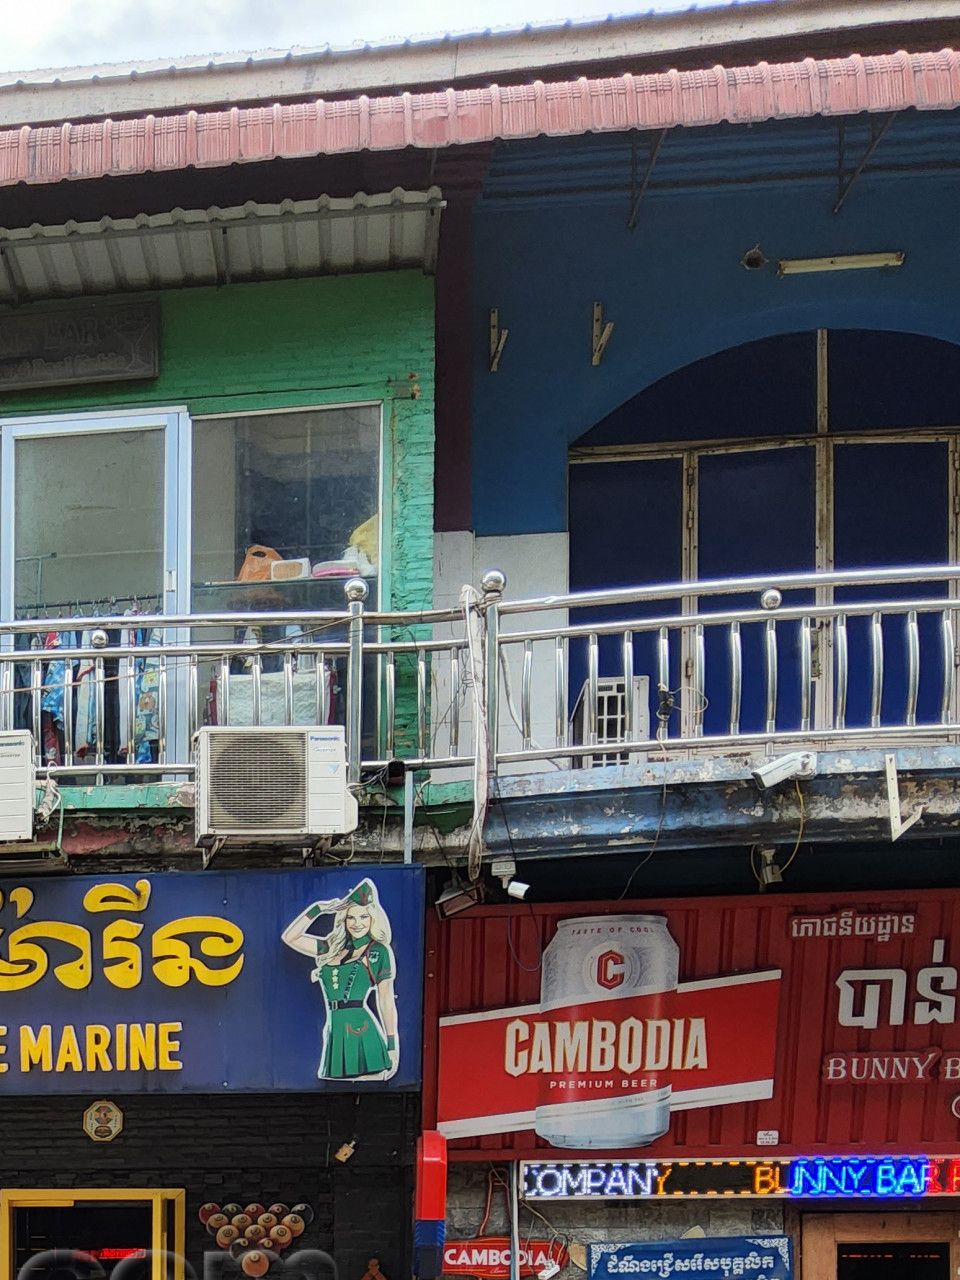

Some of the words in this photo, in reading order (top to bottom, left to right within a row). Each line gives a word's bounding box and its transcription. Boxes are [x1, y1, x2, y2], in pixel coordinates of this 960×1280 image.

[571, 927, 601, 936] TASTE
[792, 911, 915, 942] ភោជនីយដ្ឋាន
[19, 1022, 184, 1072] MARINE
[504, 1016, 708, 1077] CAMBODIA
[827, 1053, 936, 1080] BUNNY
[549, 1080, 614, 1089] PREMIUM
[622, 1079, 658, 1088] BEER
[755, 1165, 868, 1194] BUNNY
[877, 1164, 940, 1194] BAR
[444, 1248, 548, 1266] CAMBODIA
